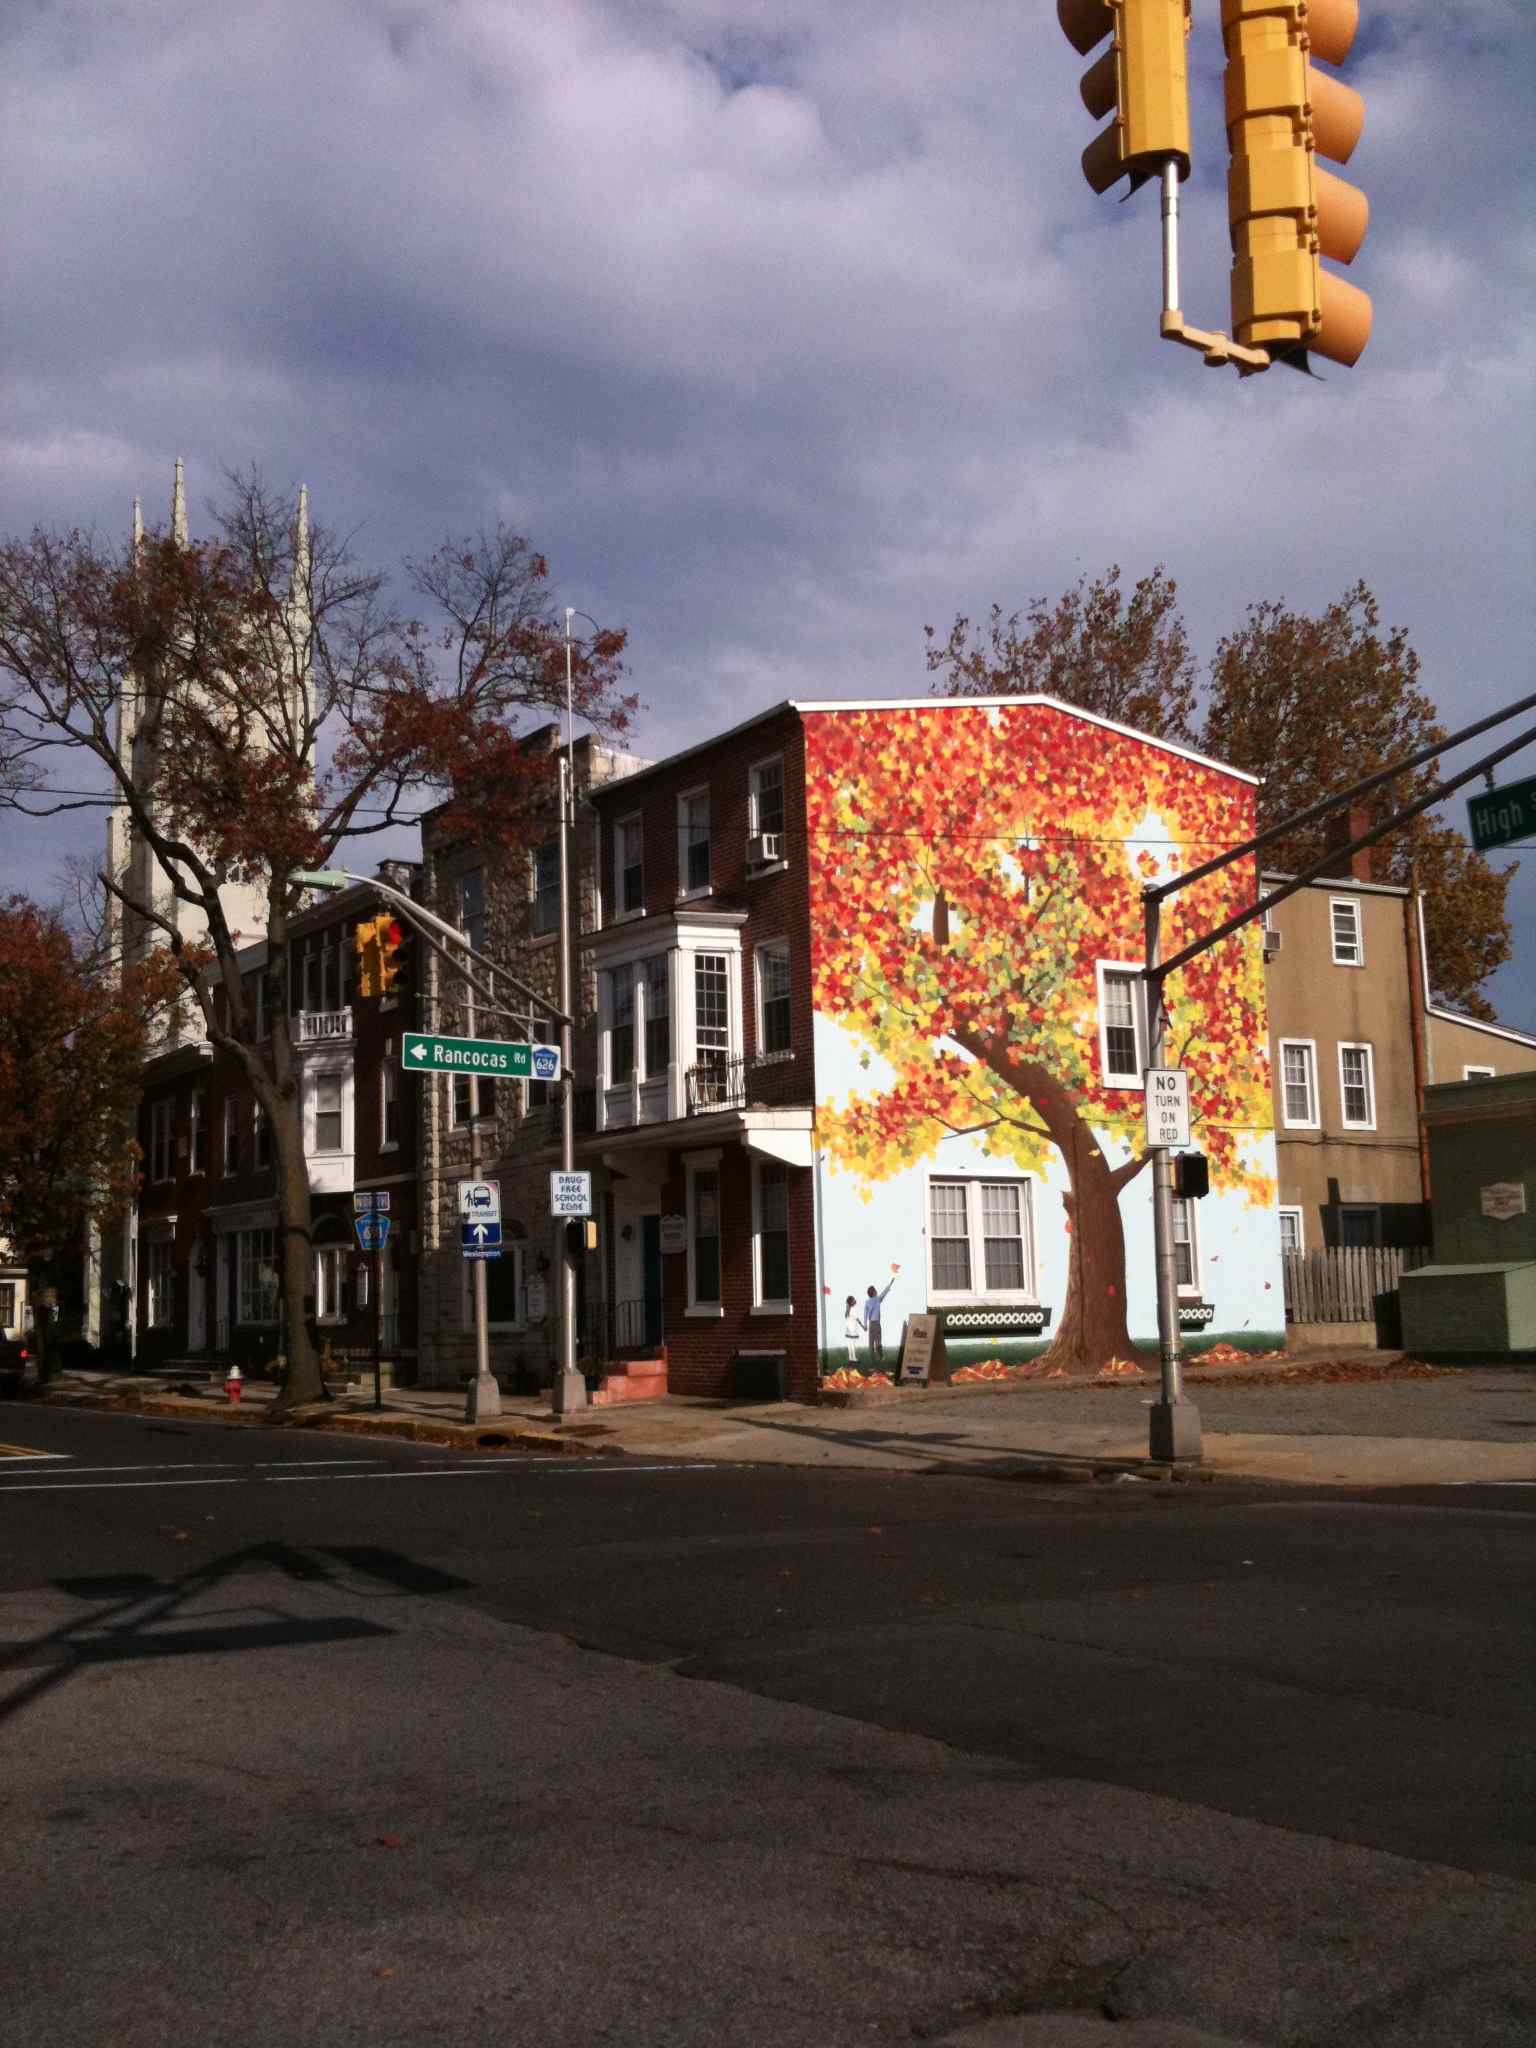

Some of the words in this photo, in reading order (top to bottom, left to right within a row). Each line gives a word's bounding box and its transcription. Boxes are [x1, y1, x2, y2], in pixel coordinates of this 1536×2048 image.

[1476, 800, 1522, 839] High
[434, 1045, 507, 1068] Rancocas
[514, 1052, 526, 1065] Rd
[536, 1058, 554, 1070] 626
[1156, 1076, 1176, 1090] NO
[1154, 1095, 1180, 1107] TURN
[1161, 1112, 1175, 1123] ON
[1160, 1128, 1177, 1140] RED
[561, 1184, 581, 1193] FREE
[554, 1193, 589, 1203] SCHOOL
[560, 1202, 583, 1211] ZONE
